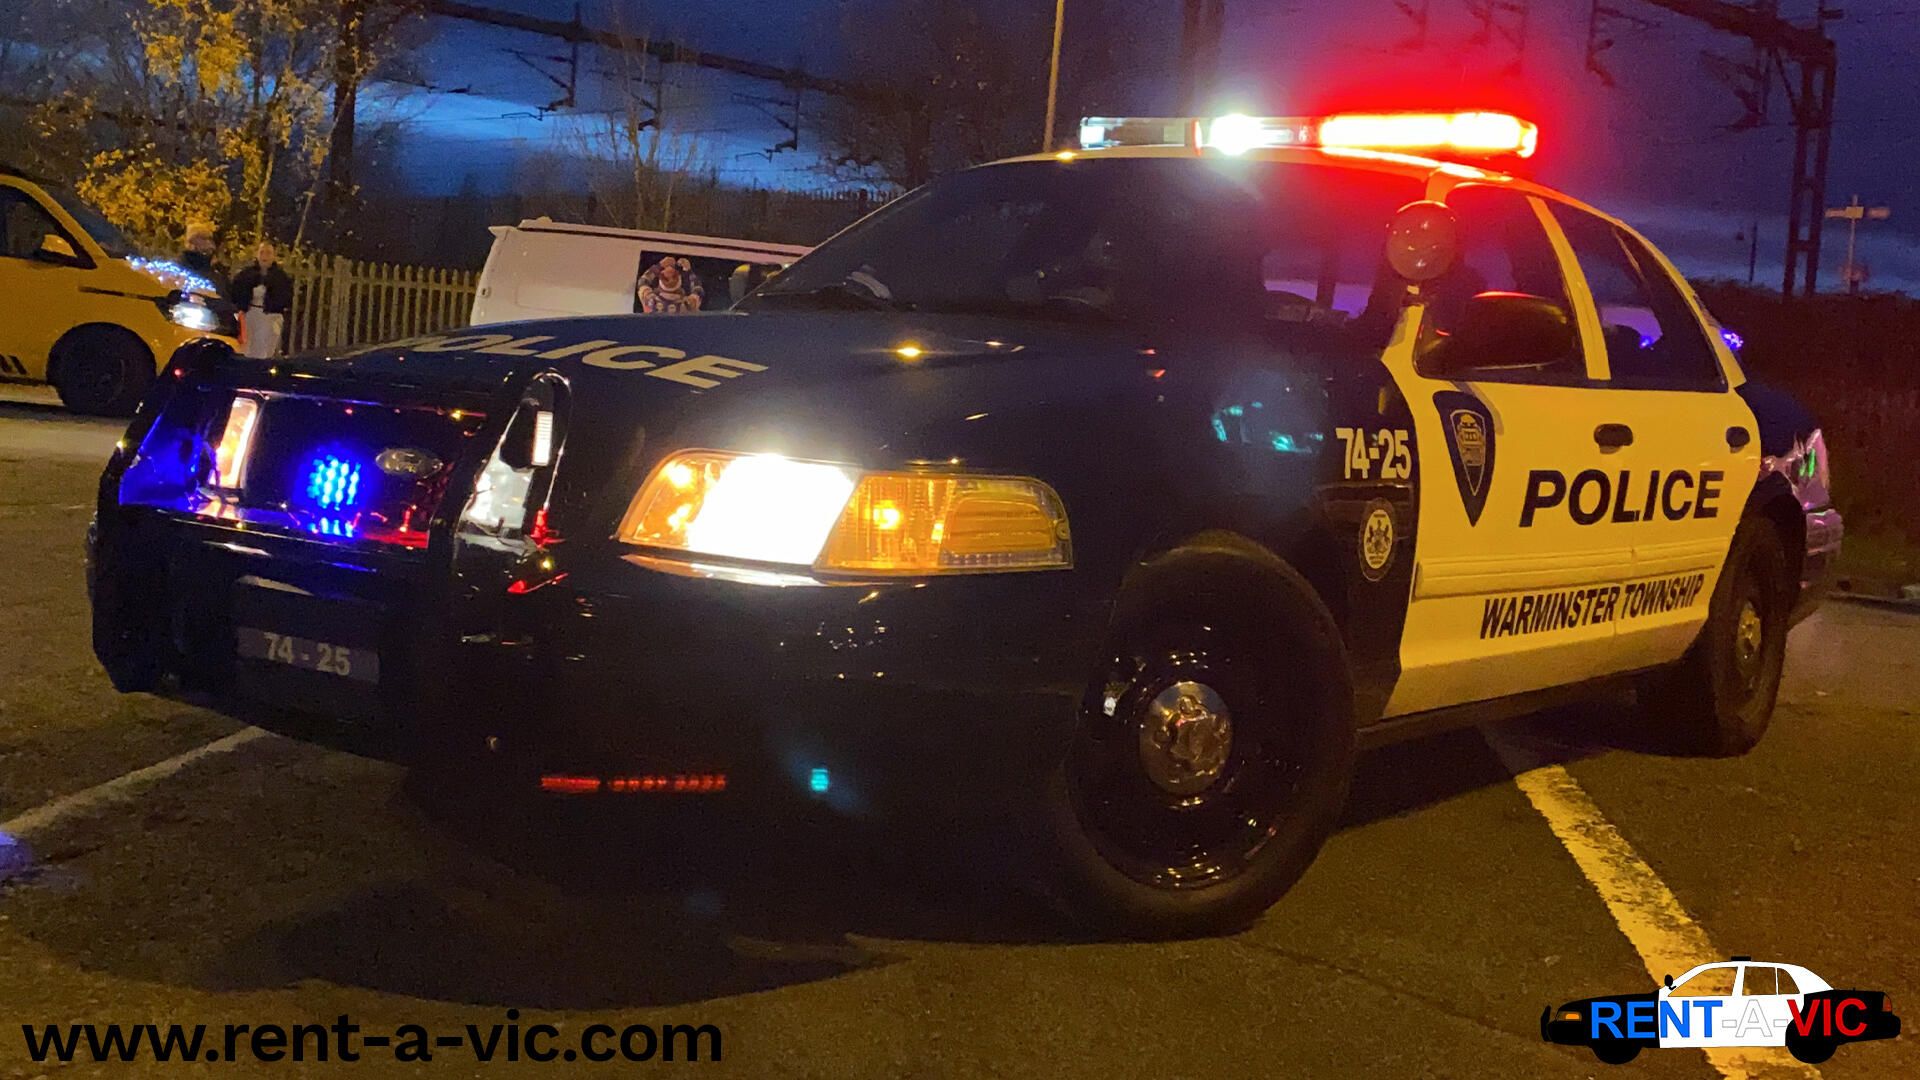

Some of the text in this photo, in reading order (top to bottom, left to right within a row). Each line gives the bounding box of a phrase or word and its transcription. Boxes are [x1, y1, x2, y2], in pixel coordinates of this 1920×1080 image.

[1335, 427, 1412, 479] 74-25
[1518, 468, 1725, 527] POLICE
[1479, 573, 1705, 640] WARMINSTER TOWNSHIP
[263, 631, 295, 665] 74
[316, 642, 351, 677] 25
